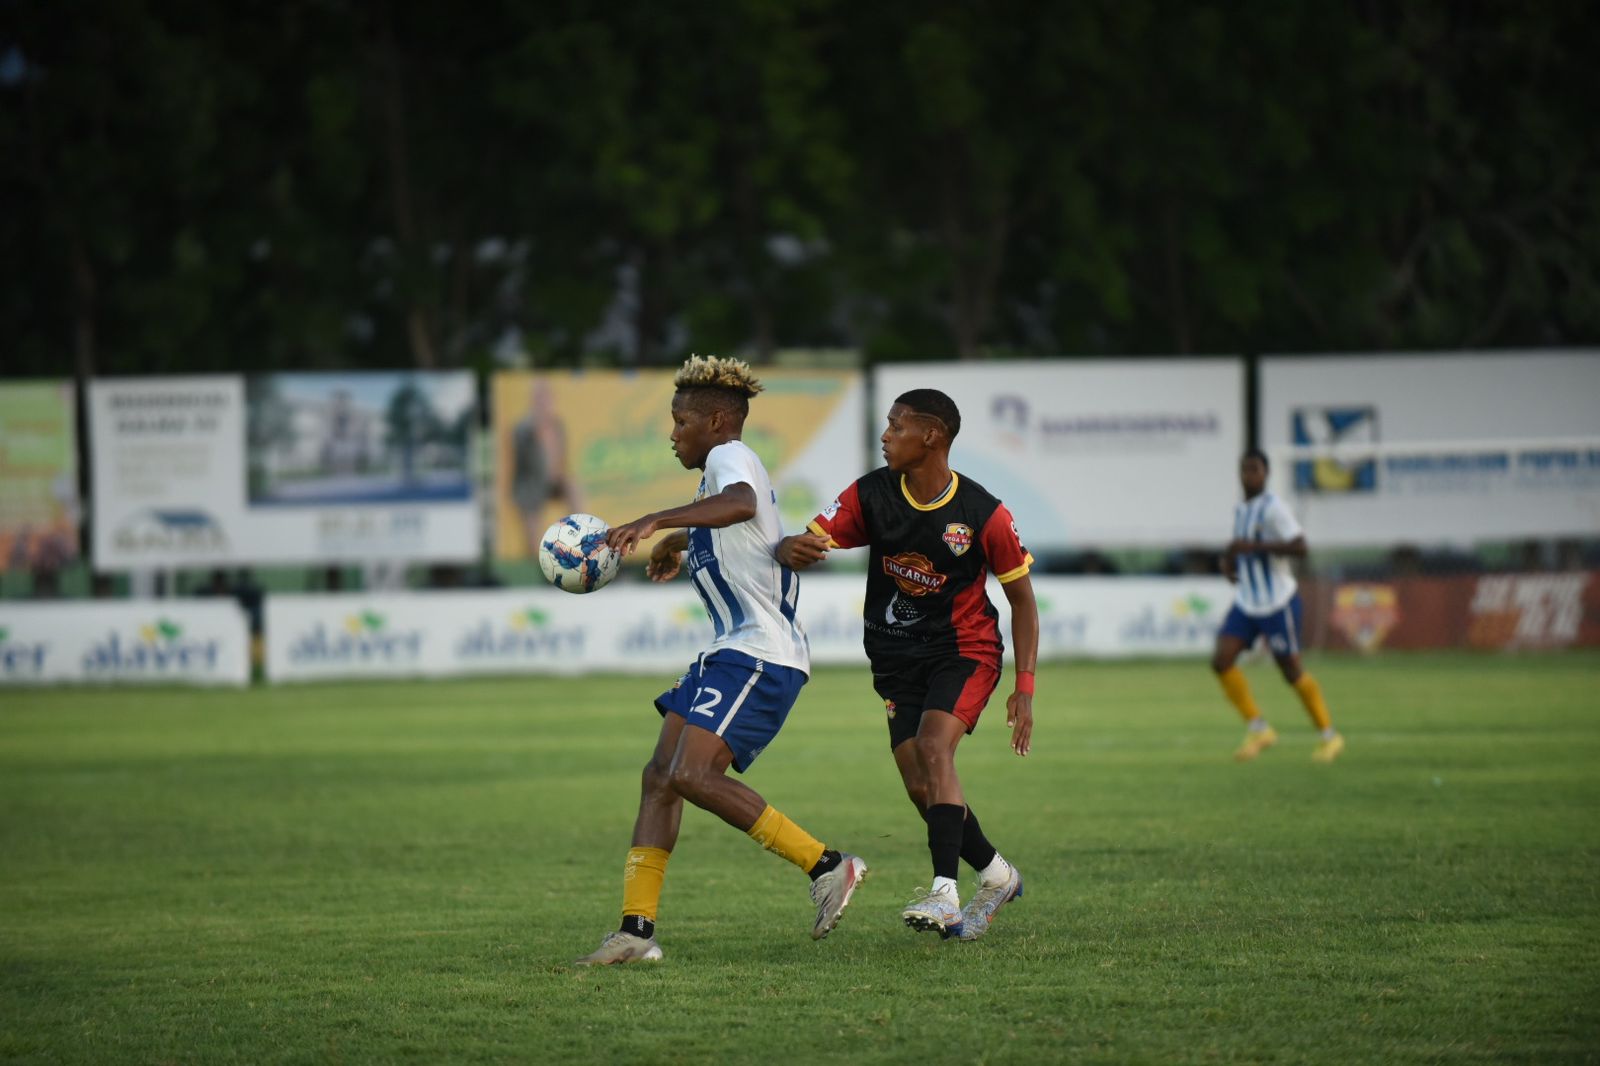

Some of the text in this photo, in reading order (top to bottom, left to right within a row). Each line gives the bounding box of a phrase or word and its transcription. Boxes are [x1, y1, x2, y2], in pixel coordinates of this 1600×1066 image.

[889, 560, 938, 587] INCARNA
[83, 630, 220, 669] alaver
[288, 623, 423, 664] alaver
